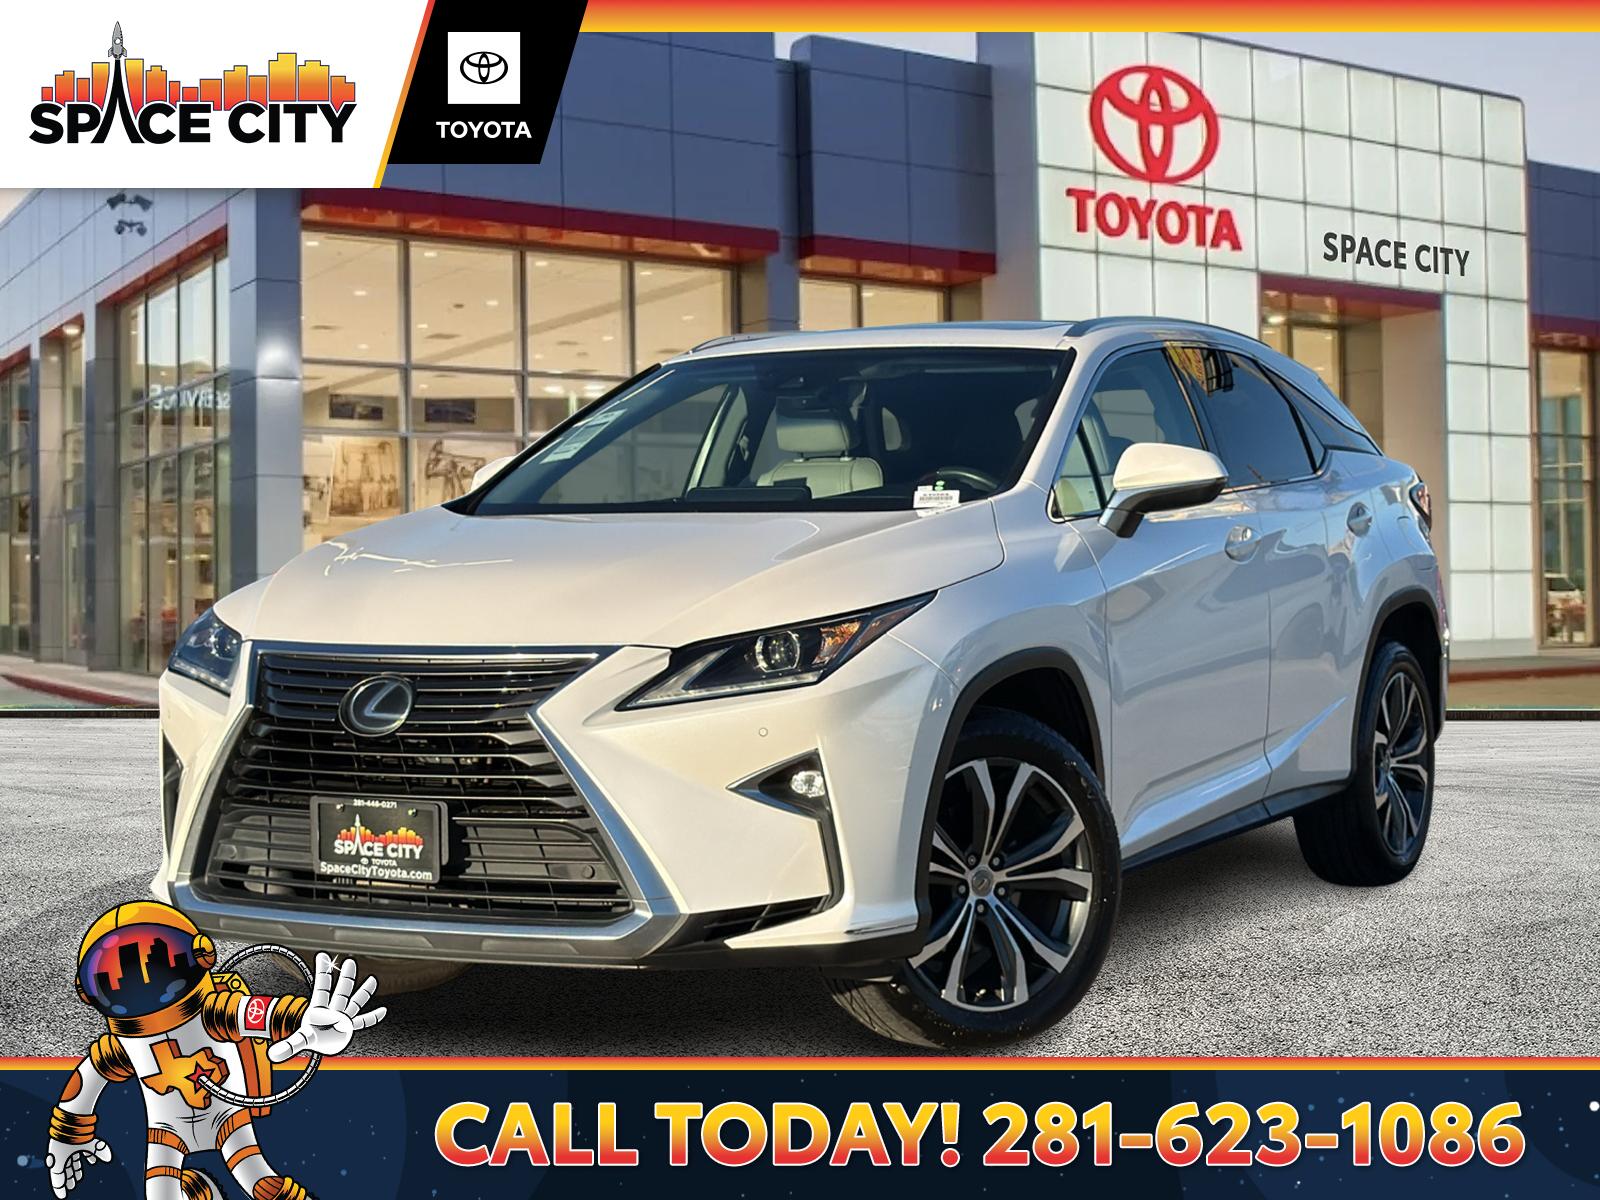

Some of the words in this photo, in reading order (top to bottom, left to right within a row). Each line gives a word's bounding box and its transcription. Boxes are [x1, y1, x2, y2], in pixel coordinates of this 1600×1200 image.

[1066, 188, 1242, 251] TOYOTA
[1323, 232, 1407, 270] SPACE
[1415, 244, 1470, 277] CITY
[334, 836, 384, 857] SPACE
[386, 843, 424, 860] CITY
[320, 861, 432, 880] SpaceCityToyota.com
[371, 858, 398, 867] TOYOTA
